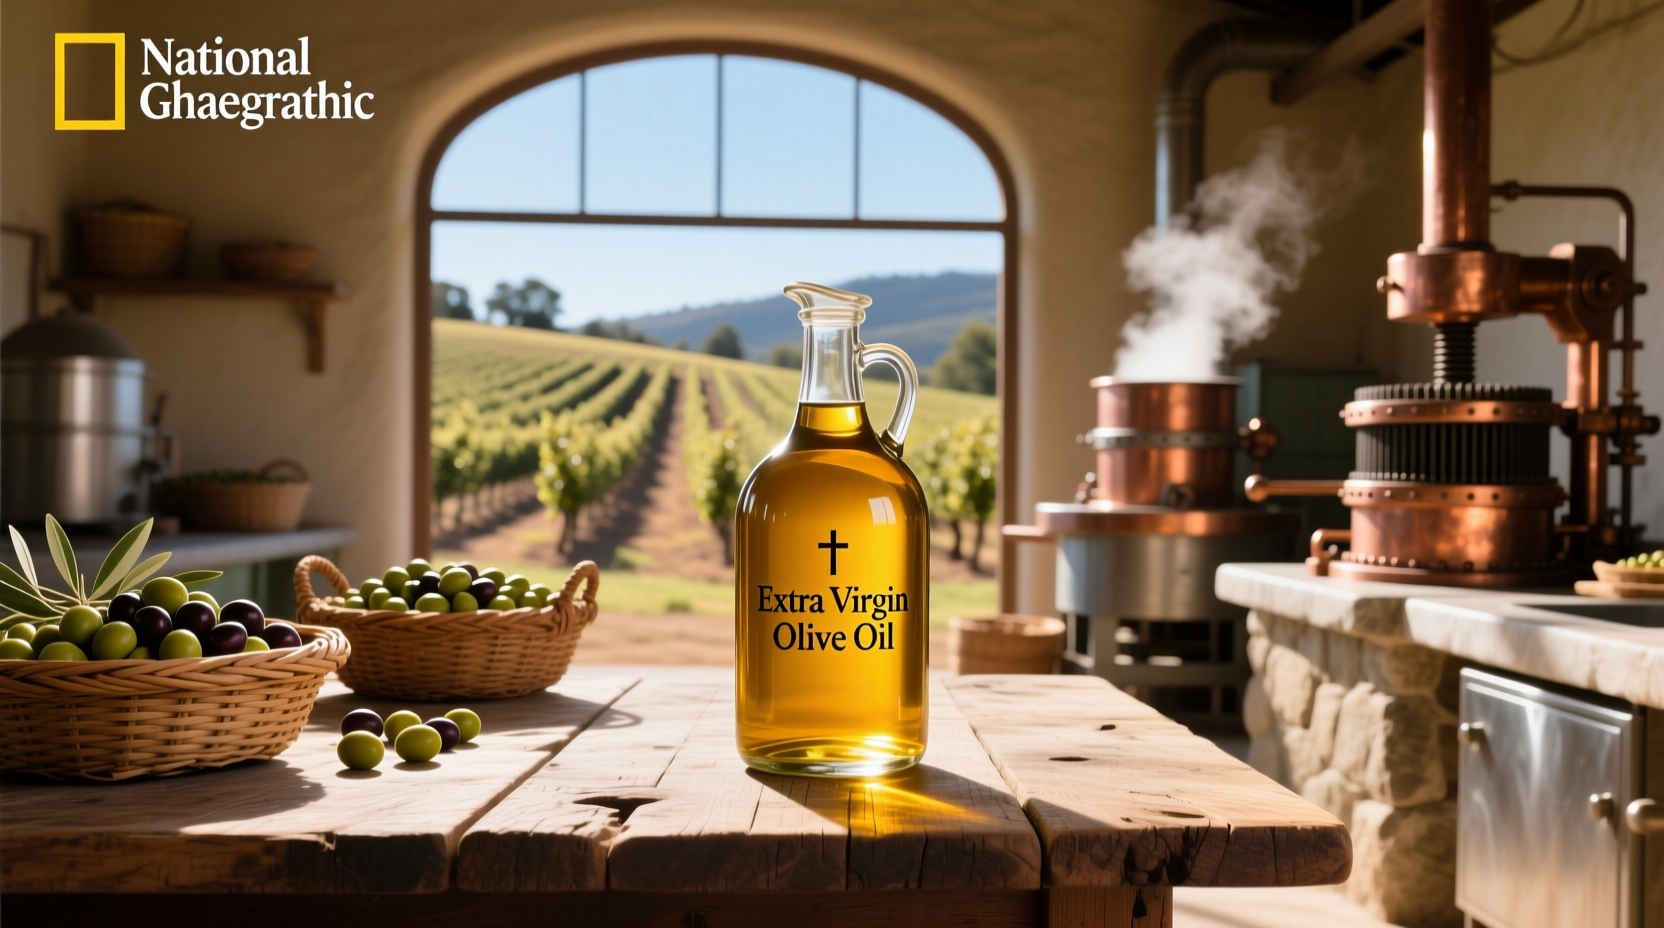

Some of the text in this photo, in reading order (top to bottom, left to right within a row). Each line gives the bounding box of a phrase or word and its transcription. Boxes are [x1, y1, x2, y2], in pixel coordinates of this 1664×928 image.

[757, 585, 909, 621] Extra Virgin
[772, 621, 895, 651] Olive Oil
